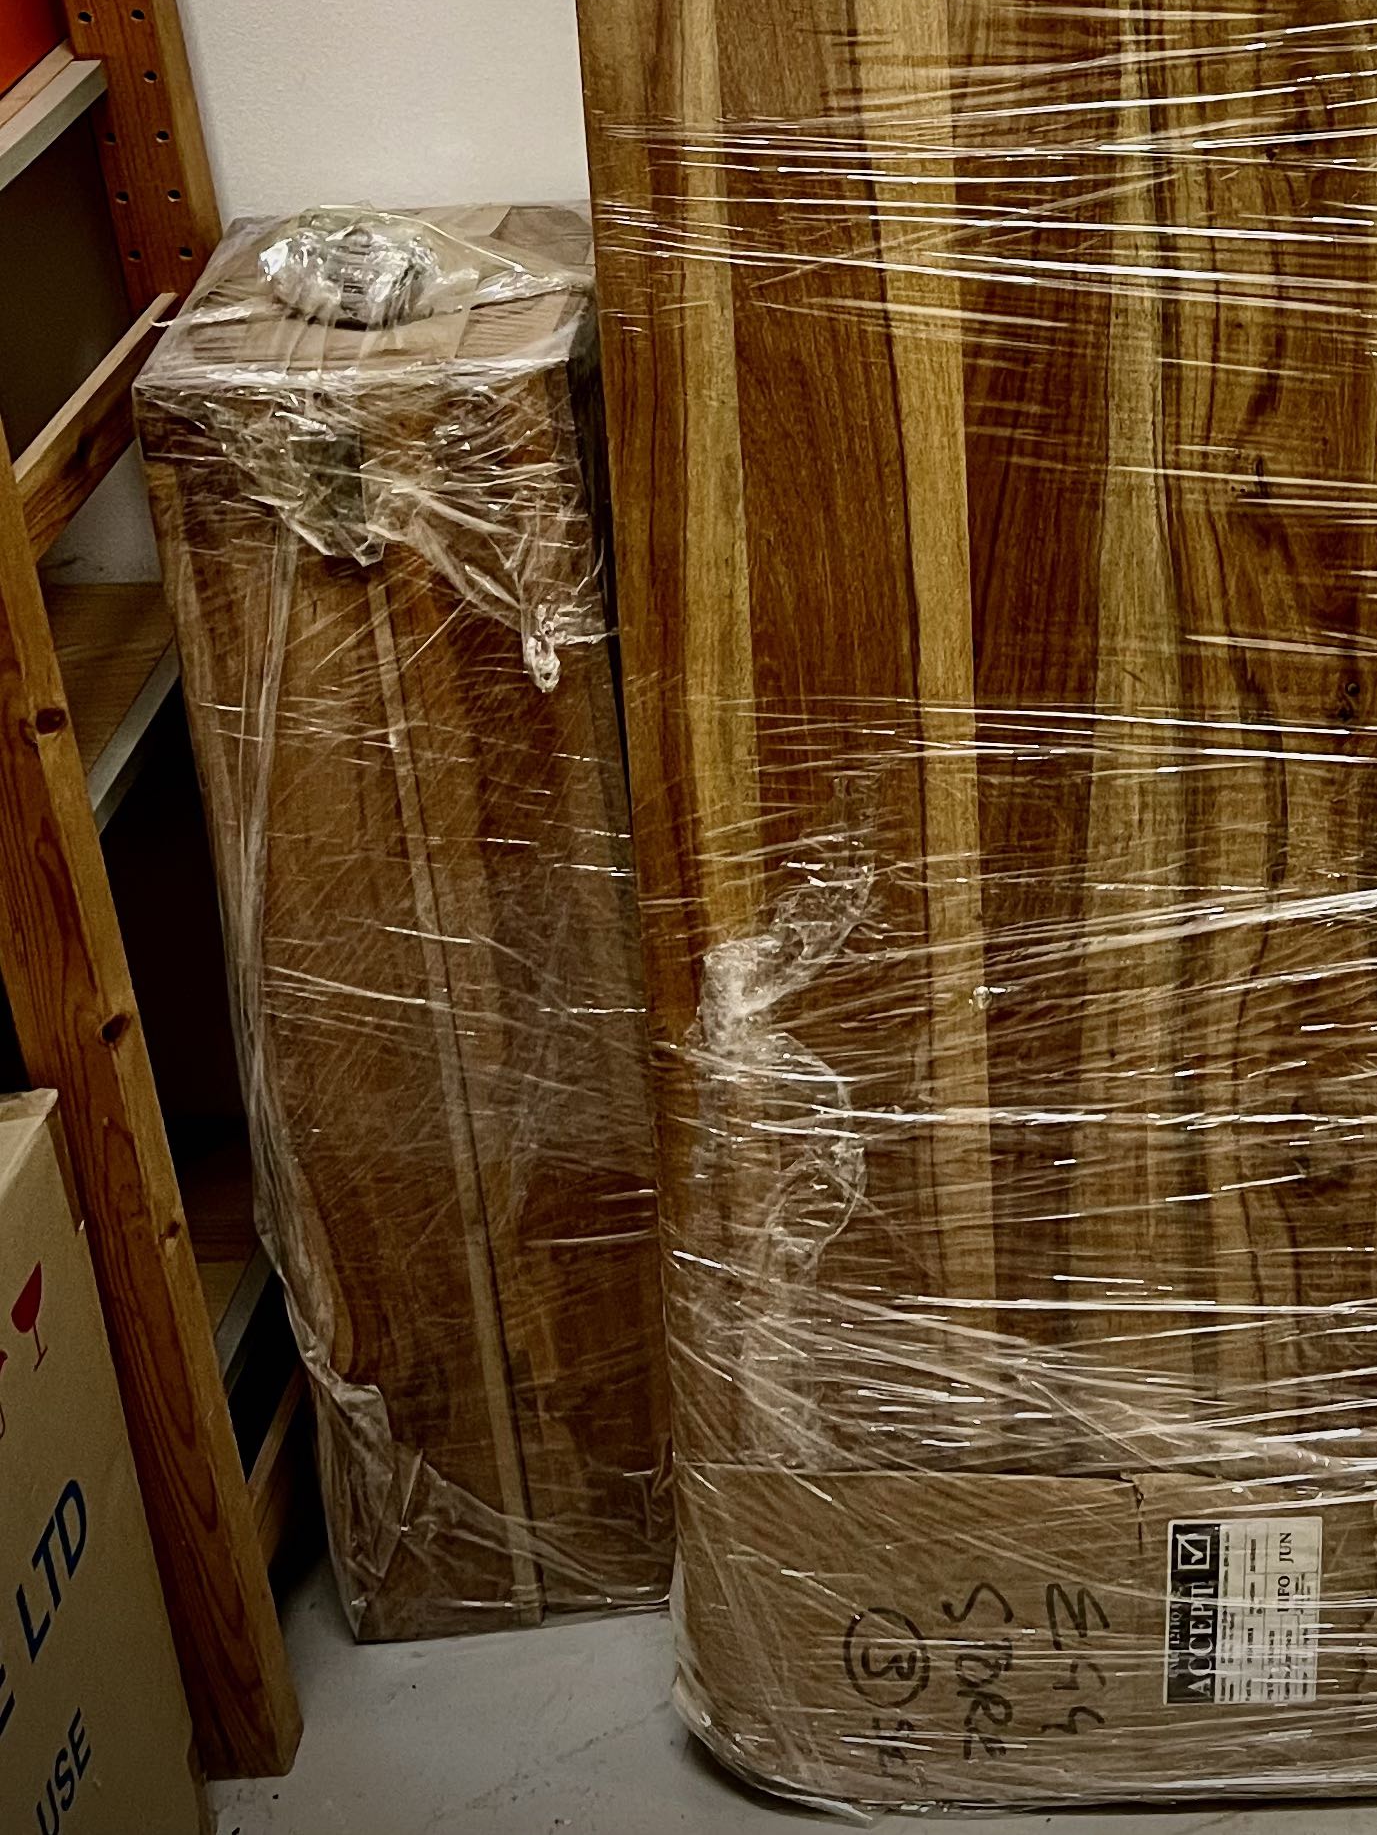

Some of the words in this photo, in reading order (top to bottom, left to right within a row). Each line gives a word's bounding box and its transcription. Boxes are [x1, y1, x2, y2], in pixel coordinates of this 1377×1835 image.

[16, 1479, 87, 1664] LTD
[1279, 1532, 1294, 1563] JUN
[1187, 1583, 1214, 1696] ACCEPT
[36, 1706, 91, 1835] USE
